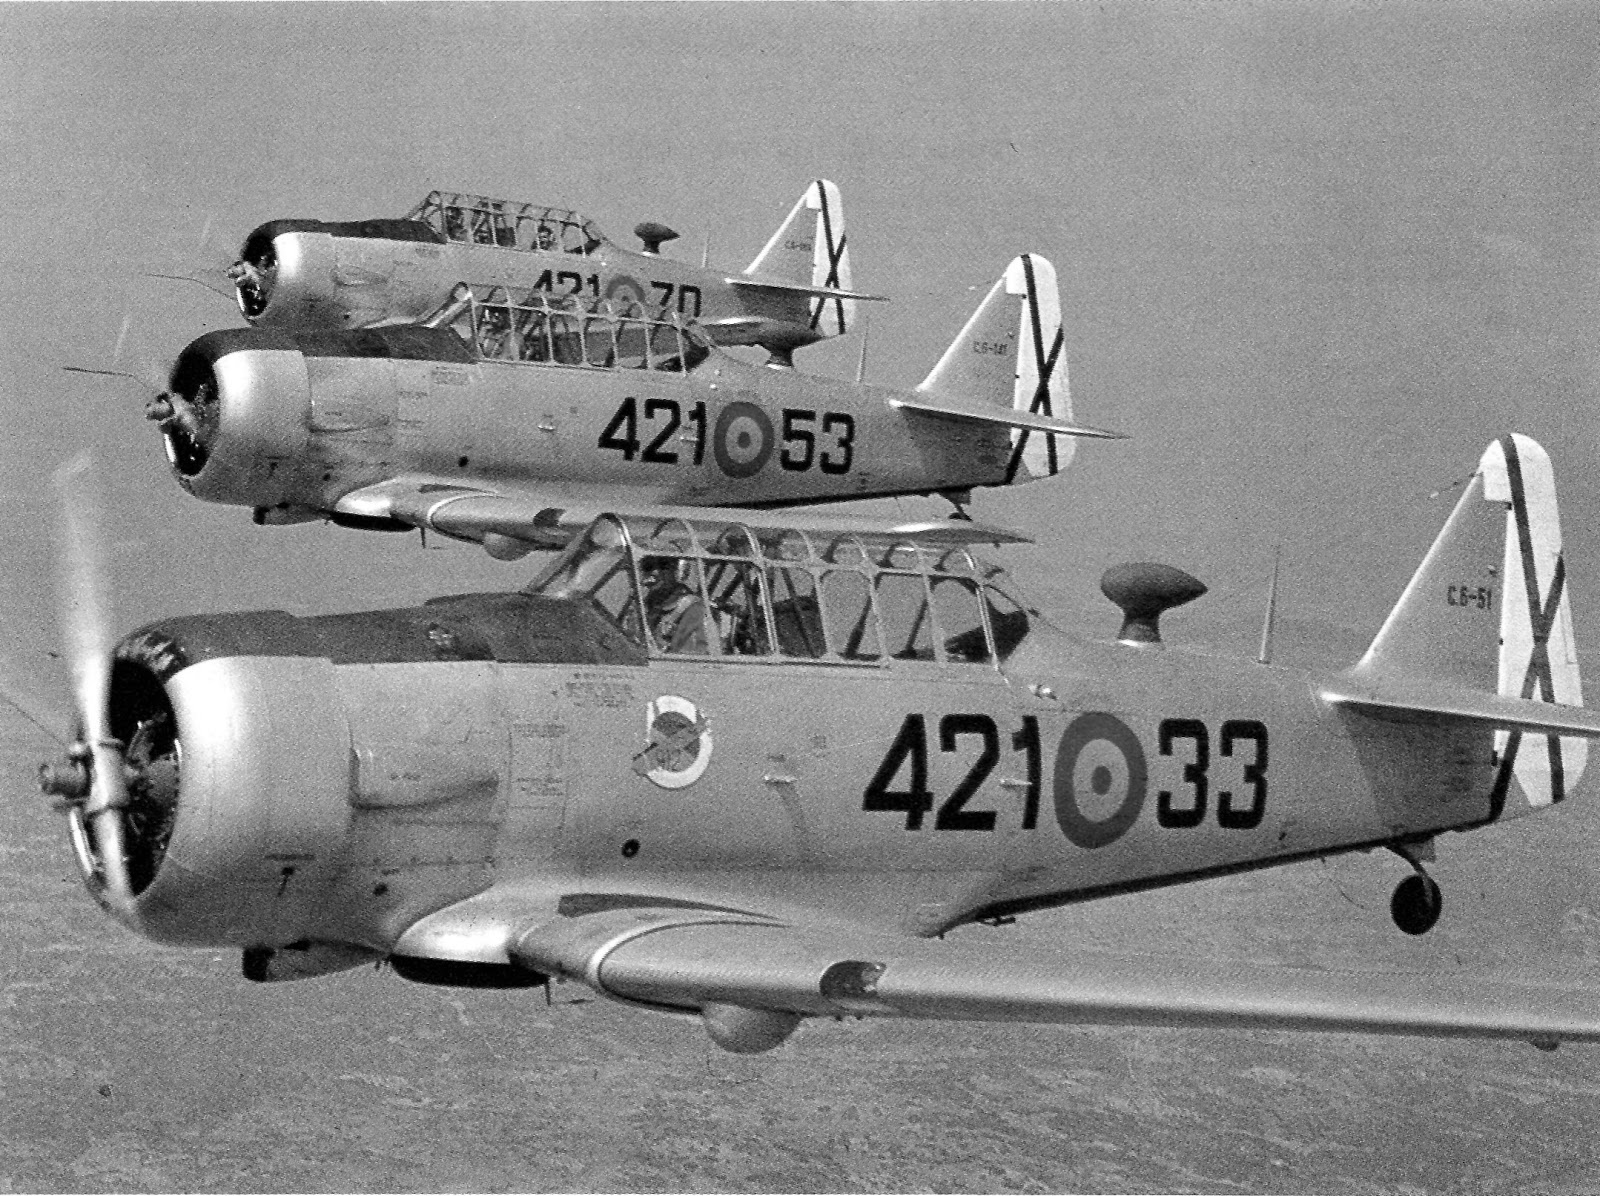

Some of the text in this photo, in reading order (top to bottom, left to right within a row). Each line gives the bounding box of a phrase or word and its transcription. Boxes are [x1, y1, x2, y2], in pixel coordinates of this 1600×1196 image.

[523, 269, 702, 326] 421 70
[598, 396, 855, 475] 421 53
[862, 713, 1269, 831] 421 33
